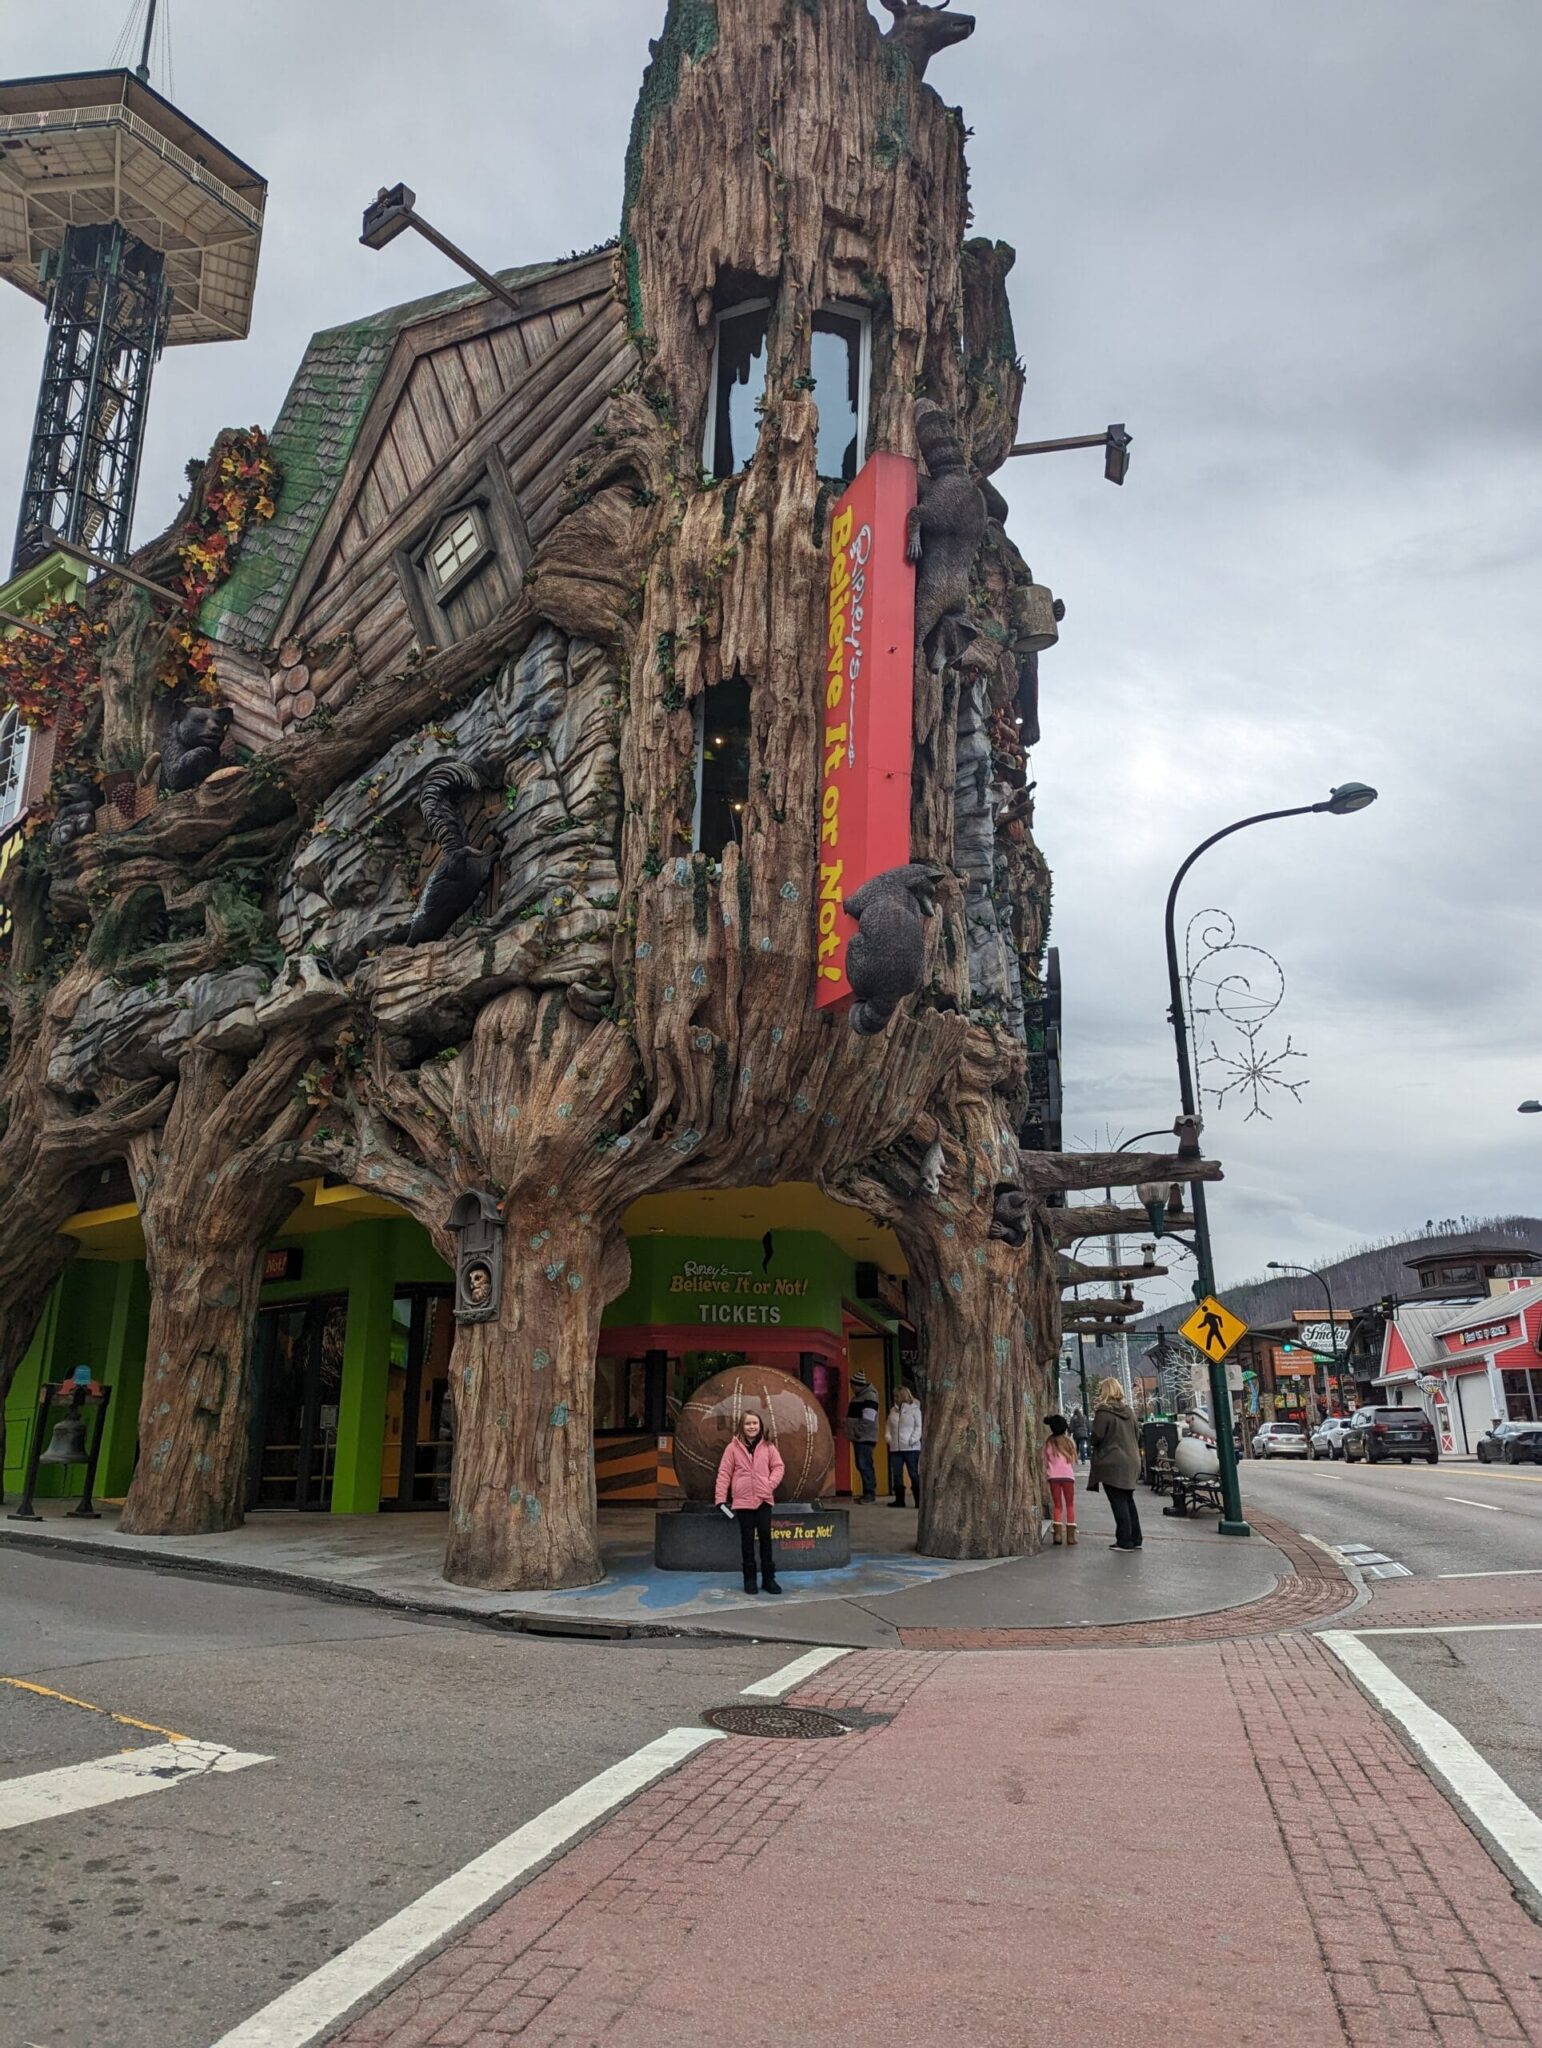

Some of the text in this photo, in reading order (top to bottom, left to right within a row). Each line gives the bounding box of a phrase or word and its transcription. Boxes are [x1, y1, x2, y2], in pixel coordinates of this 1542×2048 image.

[817, 504, 853, 982] Believe It or Not!
[669, 1275, 809, 1296] Believe It or Not!
[699, 1304, 781, 1324] TICKETS
[1303, 1326, 1348, 1342] Smoky
[793, 1526, 803, 1539] It
[804, 1530, 816, 1538] or
[816, 1525, 833, 1538] Not!
